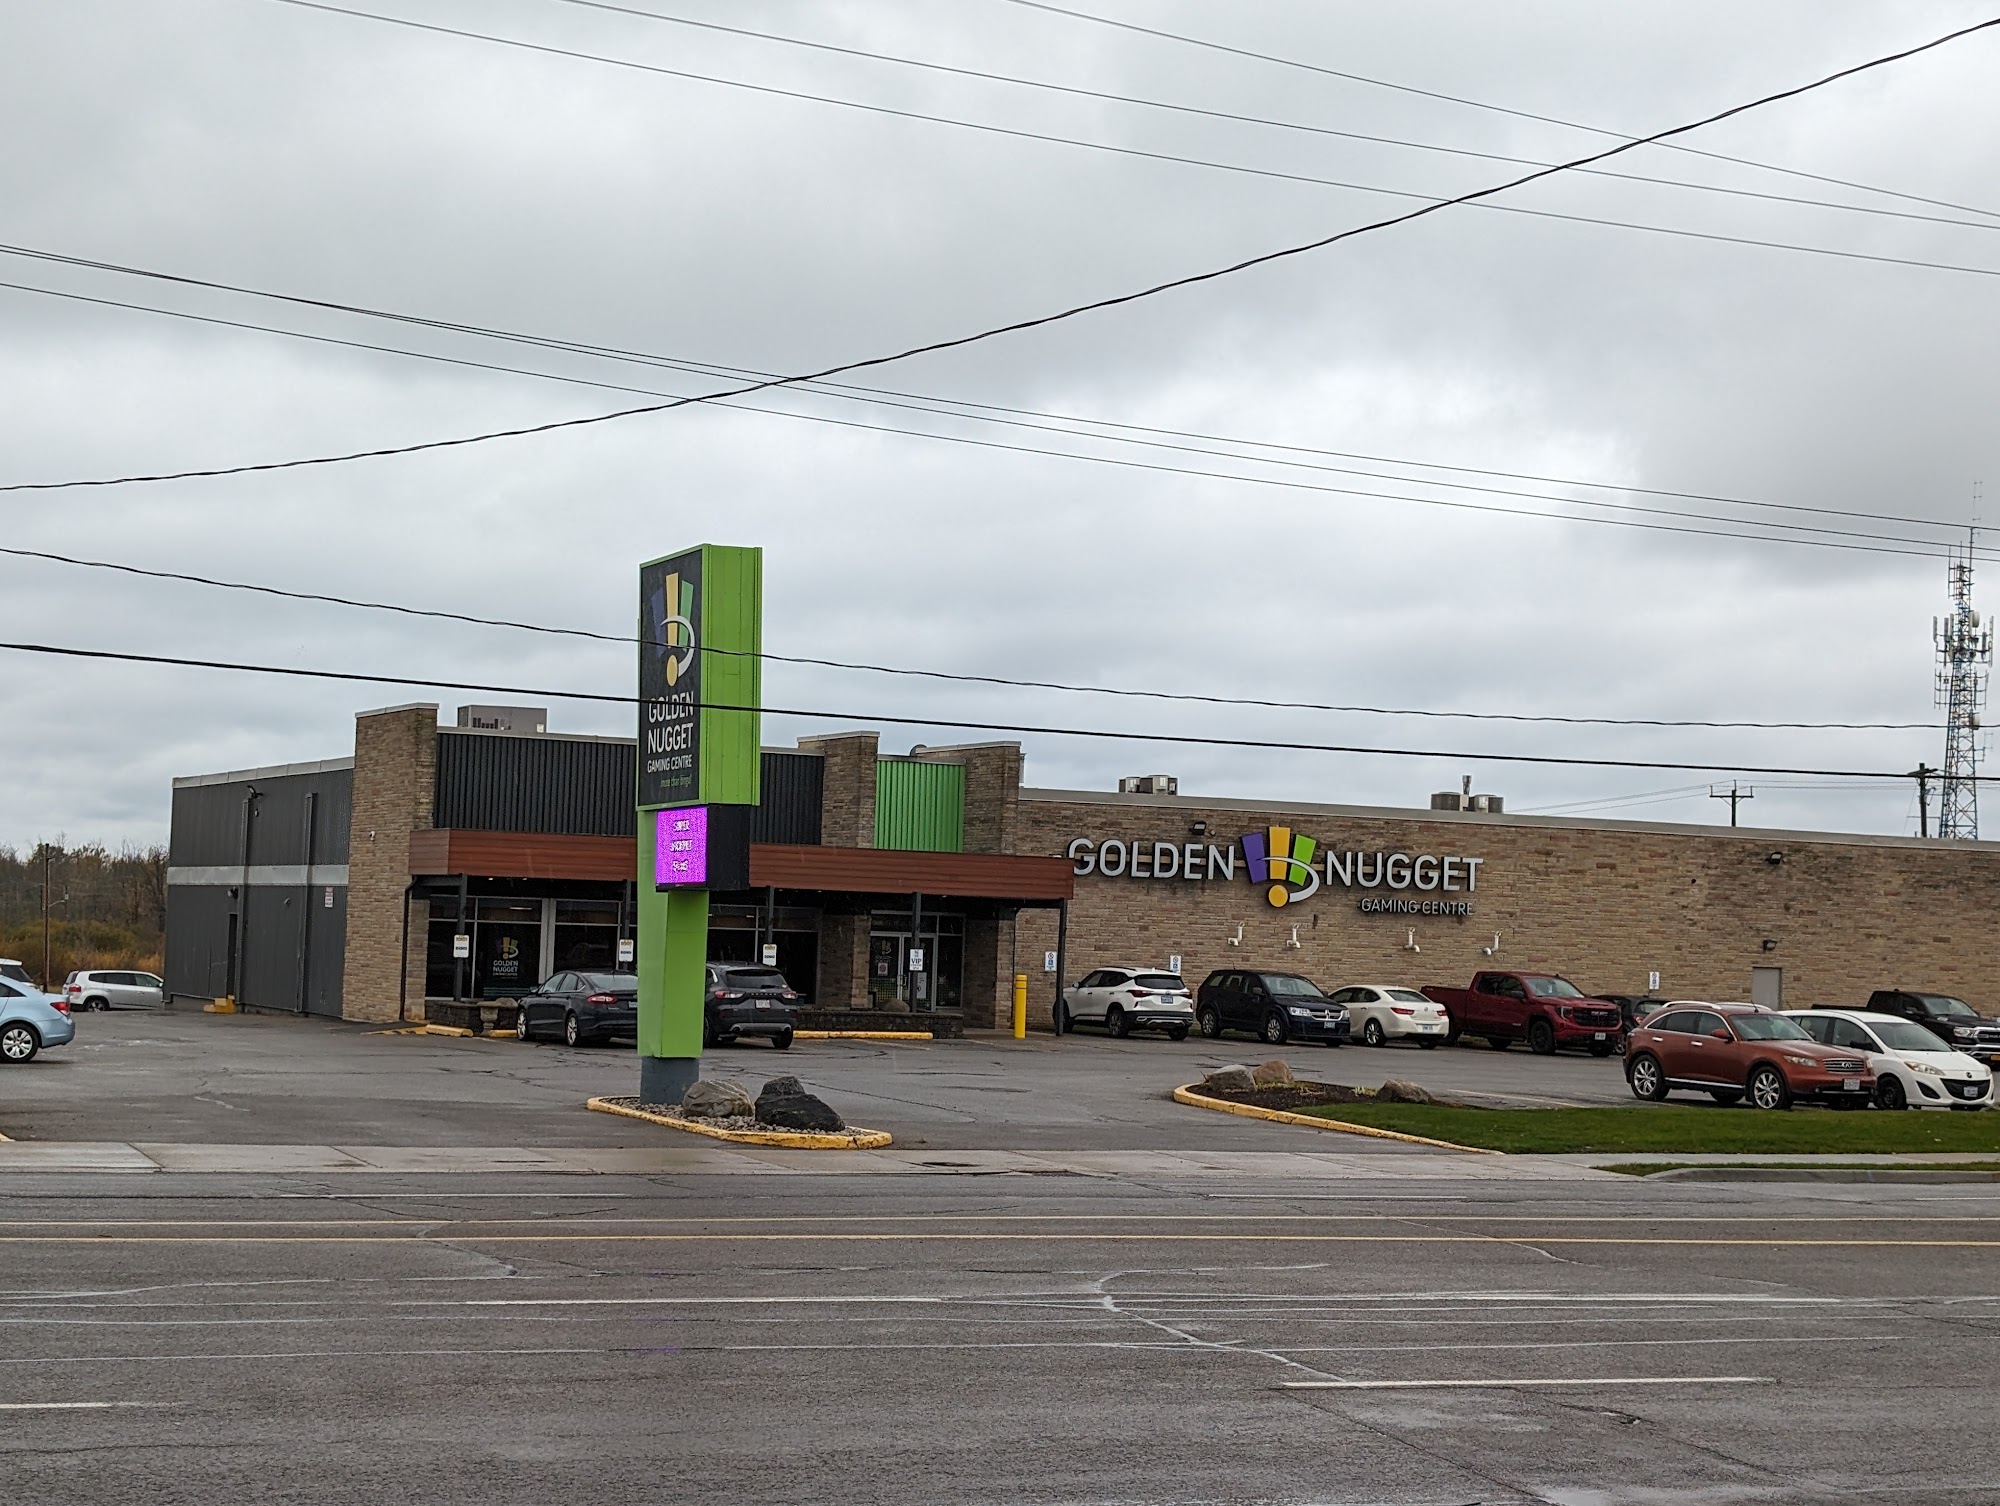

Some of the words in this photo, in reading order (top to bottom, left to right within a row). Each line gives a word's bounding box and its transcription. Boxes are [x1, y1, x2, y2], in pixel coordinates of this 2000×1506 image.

[648, 690, 694, 723] GOLDEN
[647, 723, 694, 754] NUGGET
[647, 757, 670, 773] GAMING
[670, 754, 693, 770] CENTRE
[1068, 837, 1235, 881] GOLDEN
[1325, 850, 1484, 892] NUGGET
[1360, 898, 1418, 914] GAMING
[1421, 901, 1474, 916] CENTRE
